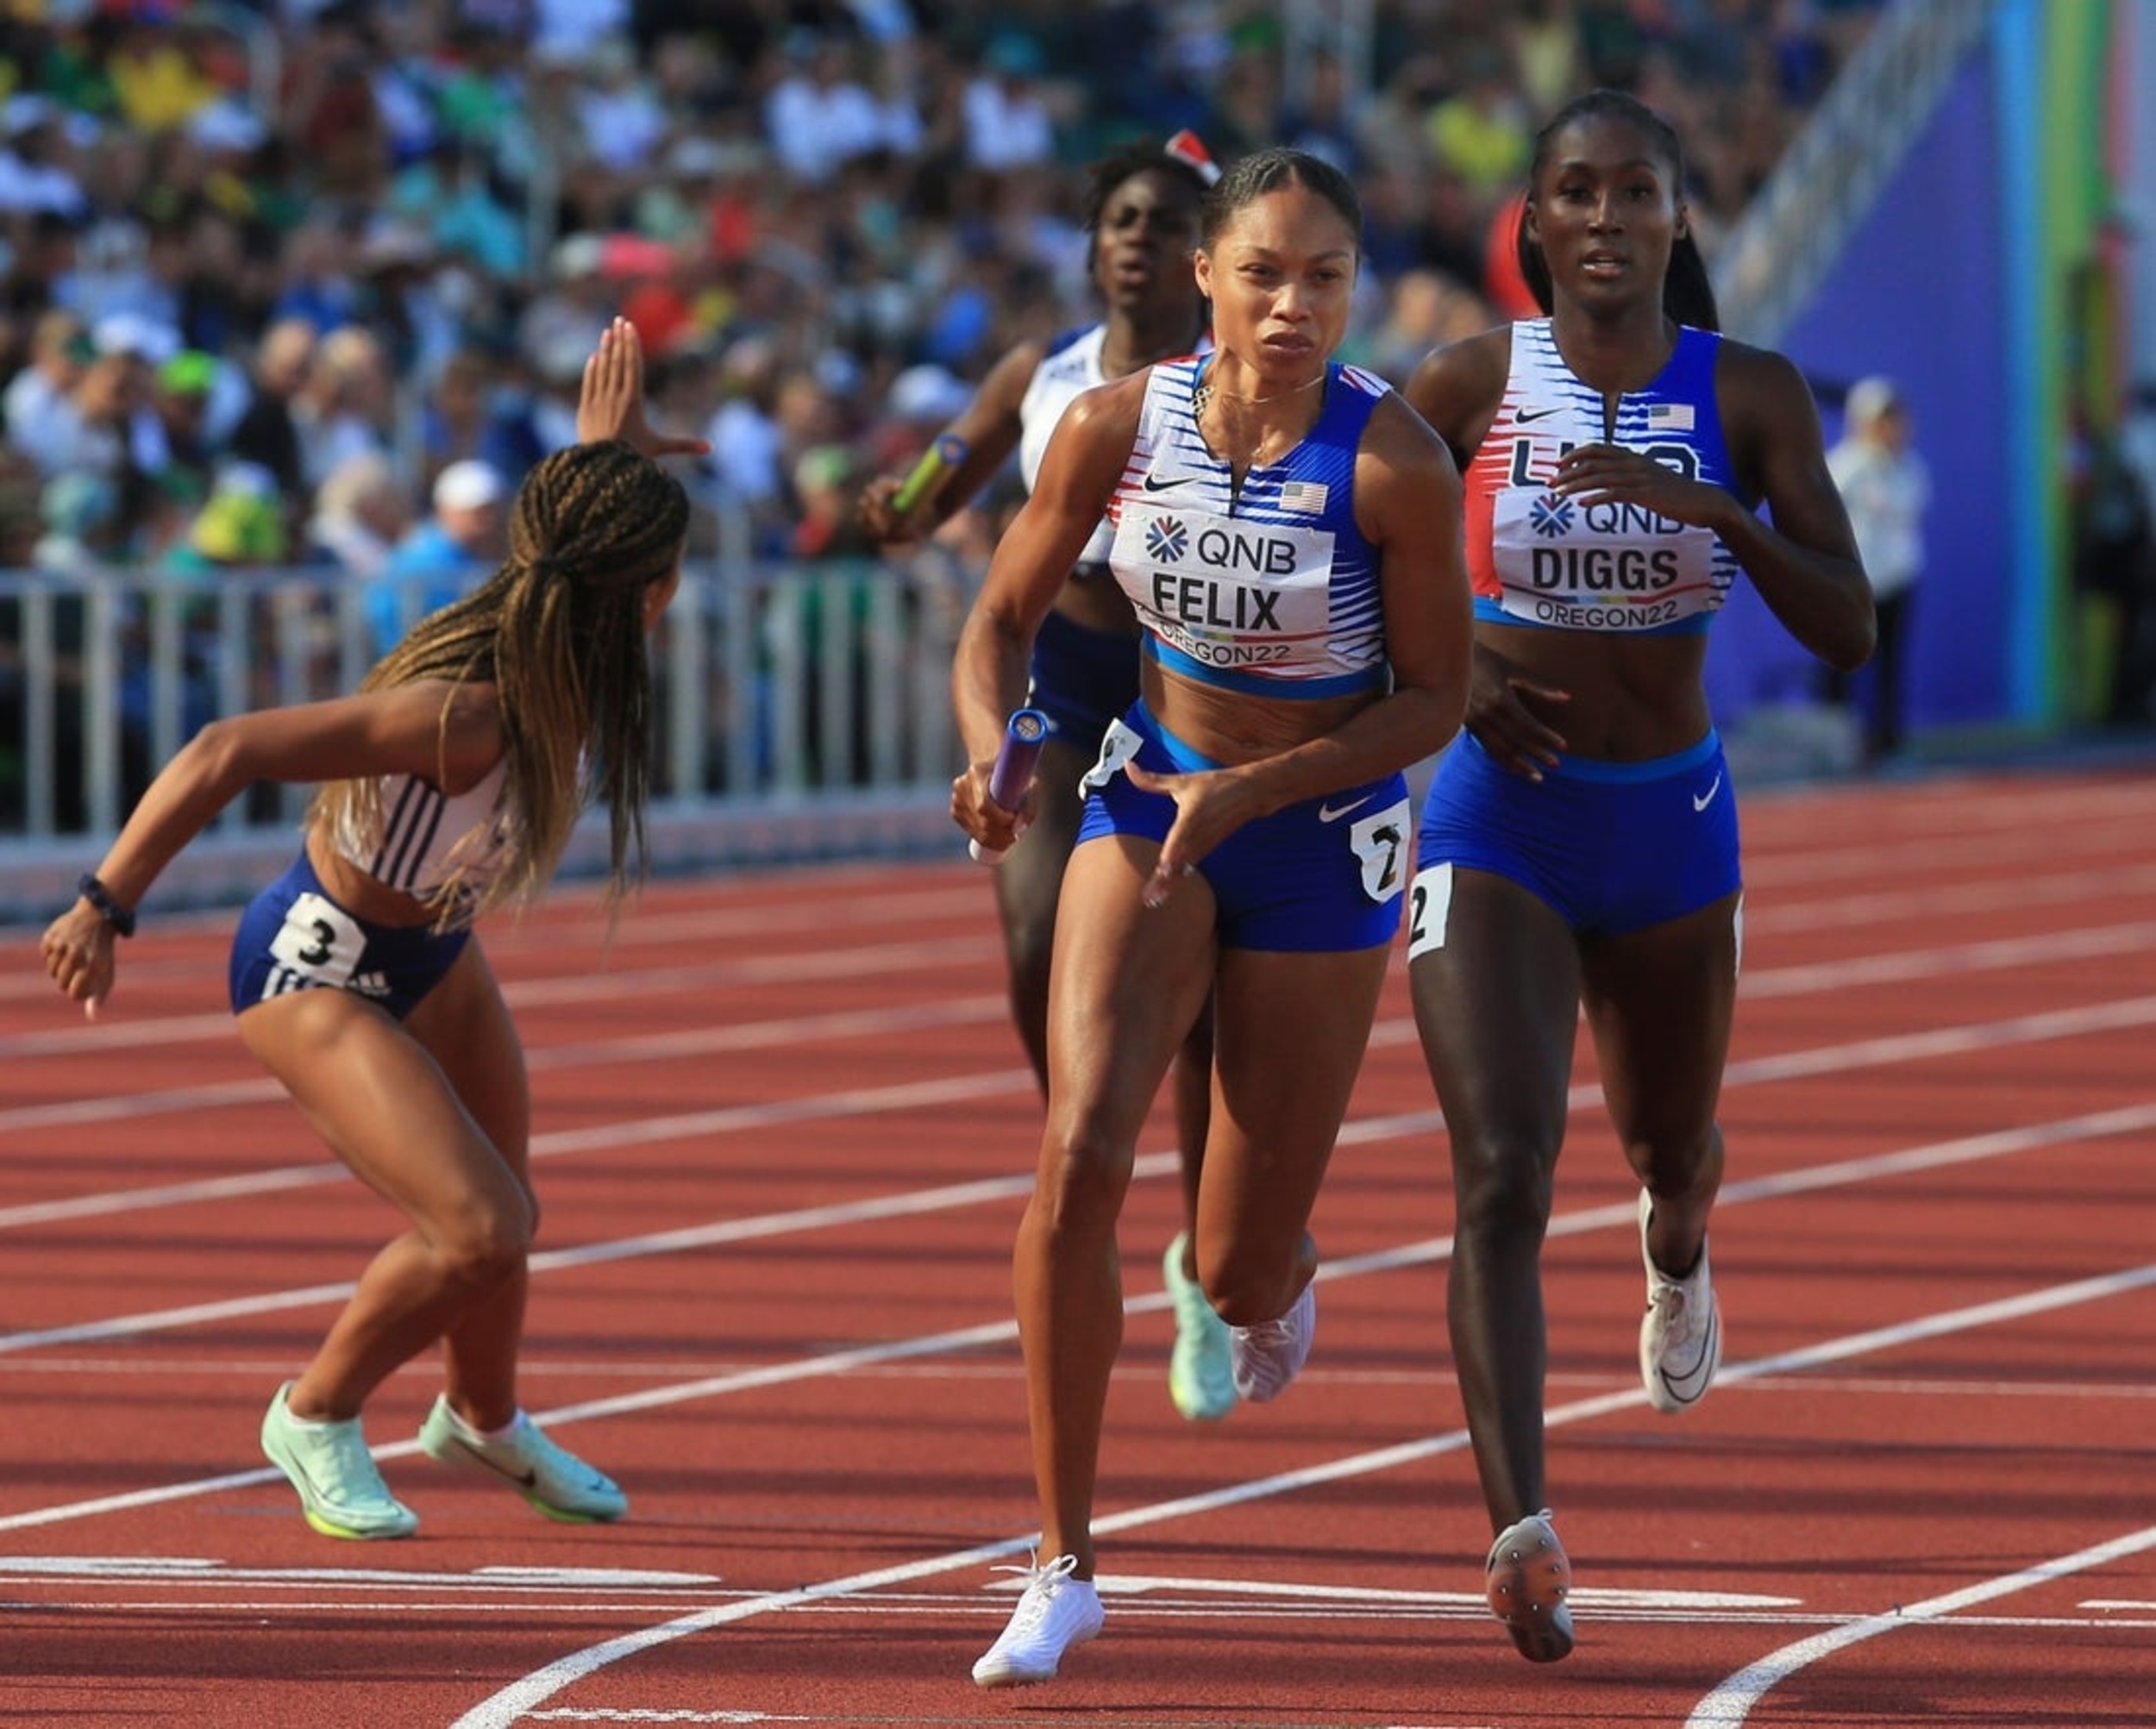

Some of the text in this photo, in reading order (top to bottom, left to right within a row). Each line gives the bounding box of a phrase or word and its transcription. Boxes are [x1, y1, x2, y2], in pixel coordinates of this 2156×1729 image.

[1197, 529, 1296, 574] QNB
[1532, 548, 1678, 591] DIGGS
[1152, 572, 1282, 631] FELIX
[1535, 600, 1679, 628] OREGON22
[1160, 620, 1291, 665] OREGON22
[1409, 885, 1427, 944] 2
[298, 918, 336, 966] 3
